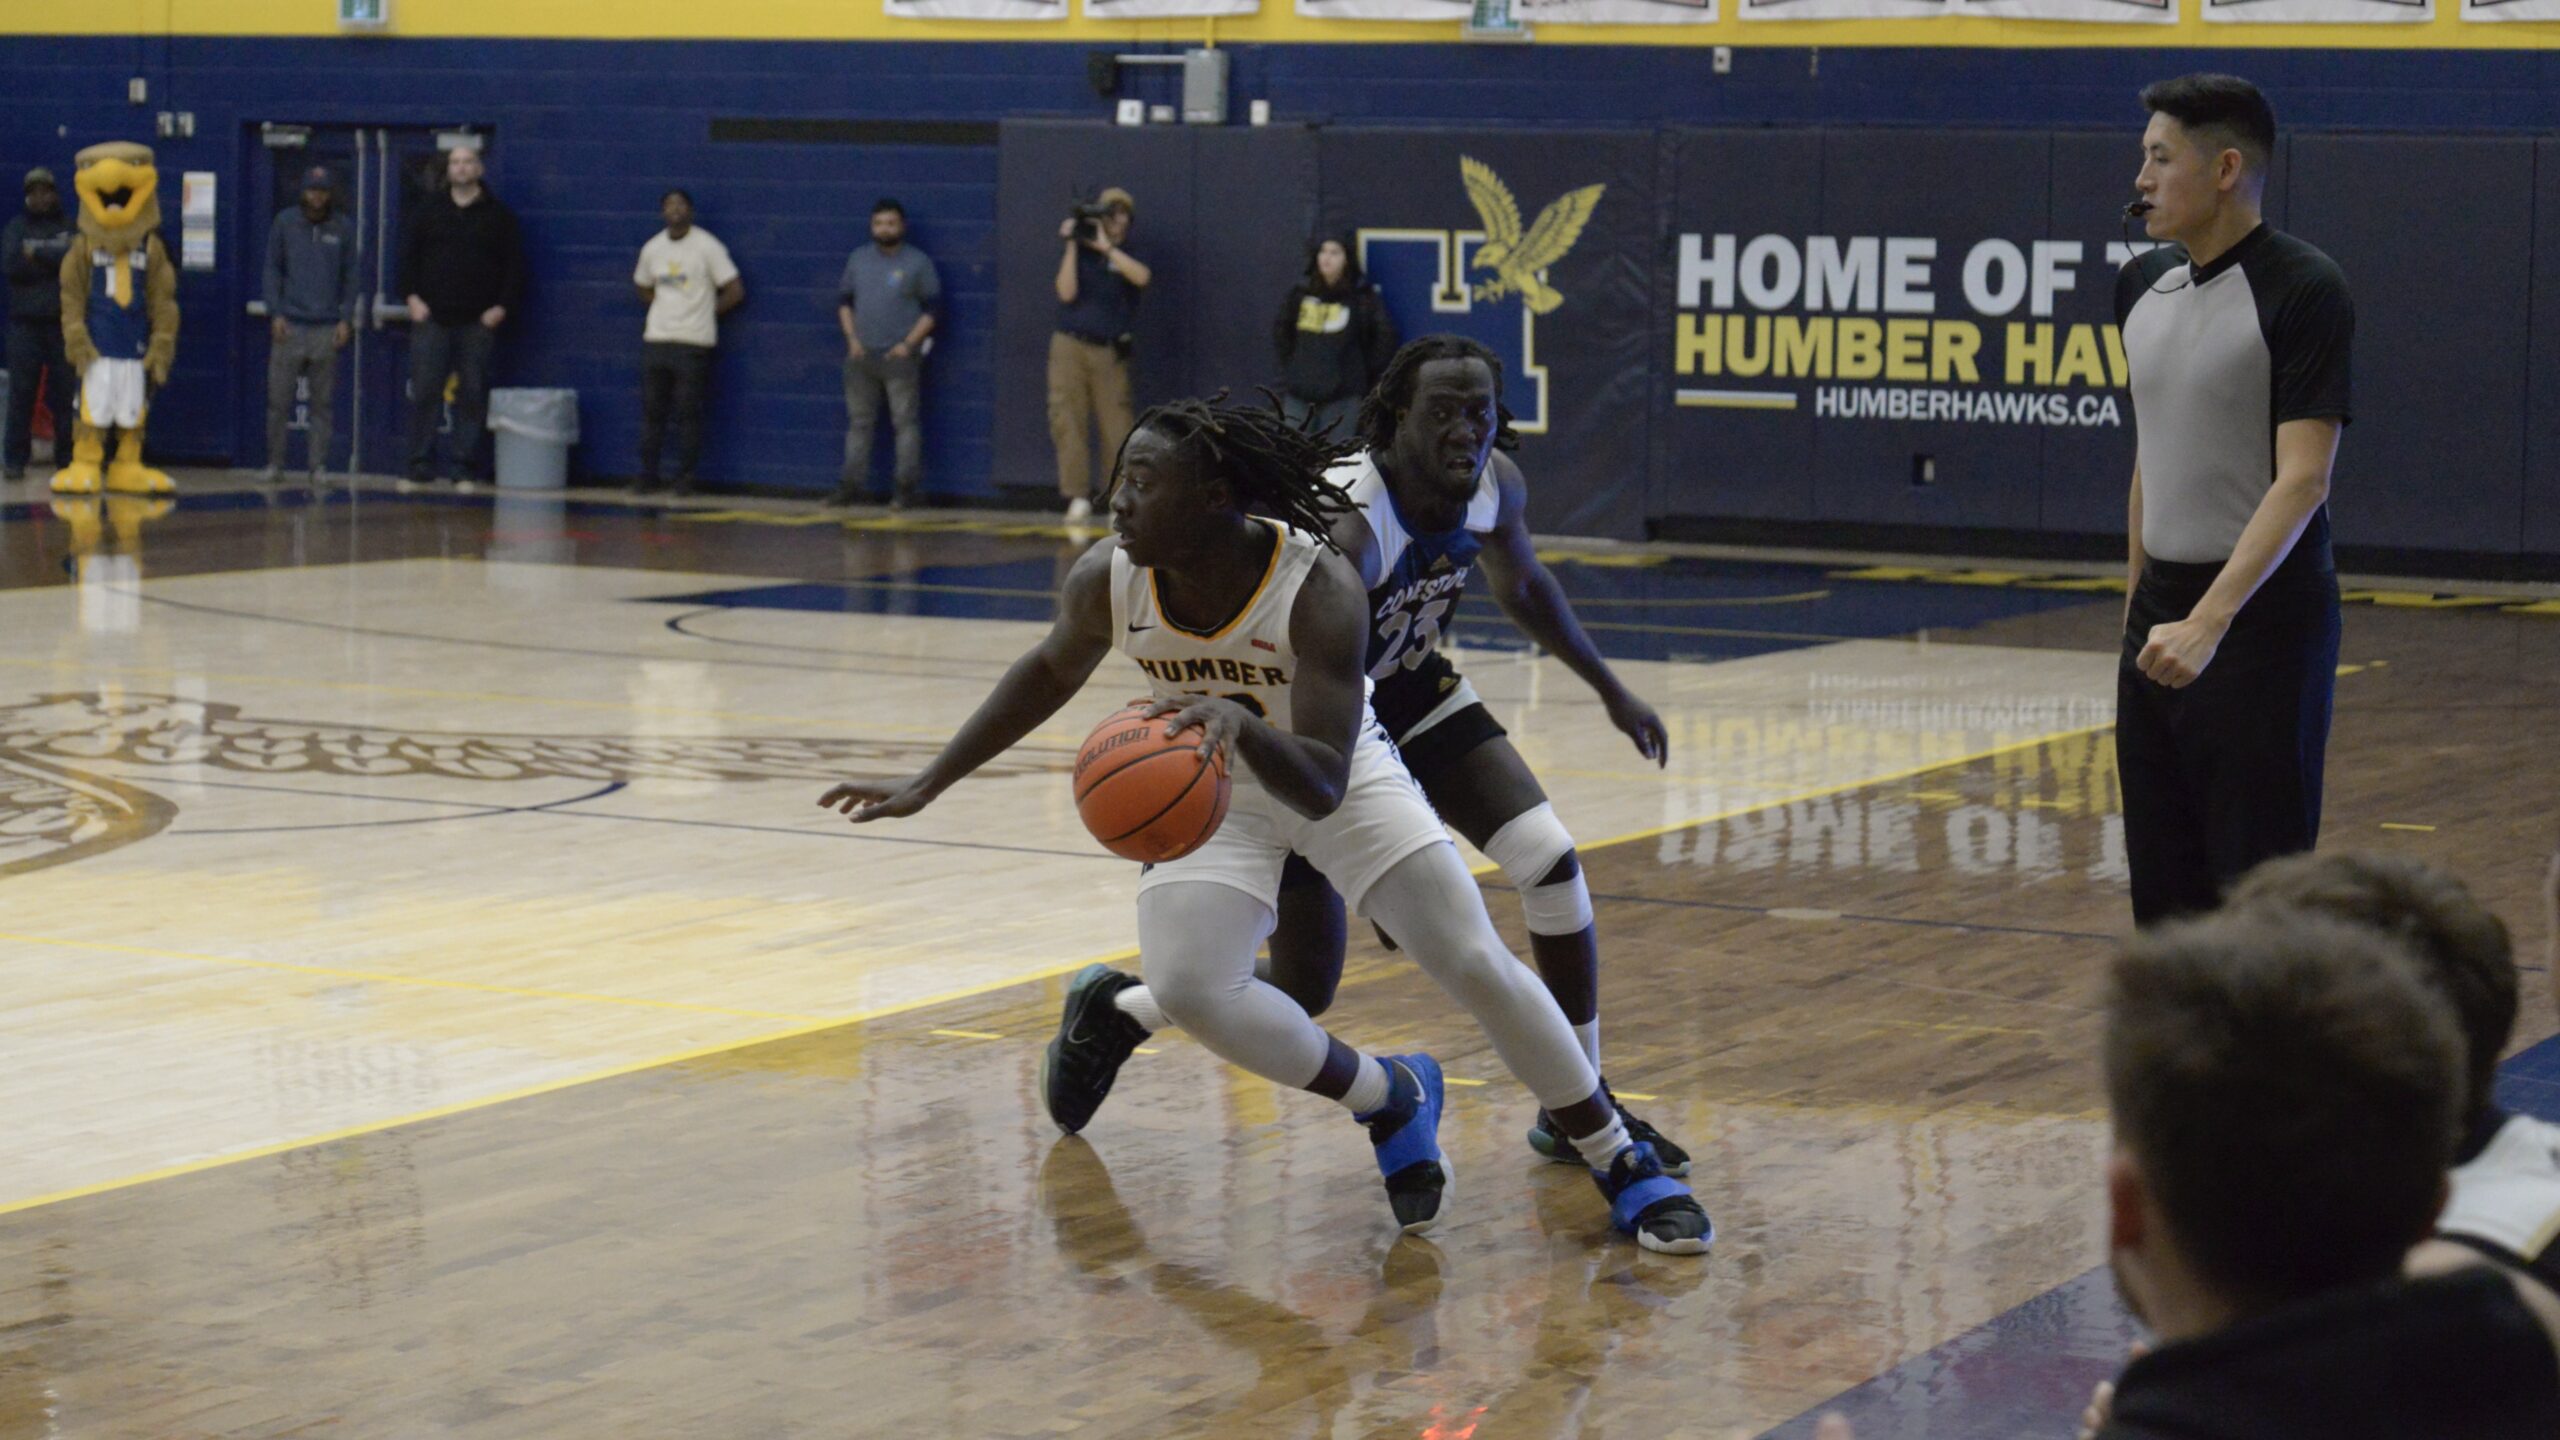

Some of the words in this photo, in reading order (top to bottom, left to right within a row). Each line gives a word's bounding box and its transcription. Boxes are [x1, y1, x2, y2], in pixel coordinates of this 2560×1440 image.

[1677, 233, 1936, 313] HOME
[1963, 238, 2083, 316] OF
[1675, 313, 1982, 382] HUMBER
[1815, 387, 2120, 426] HUMBERHAWKS.CA
[1135, 656, 1291, 686] HUMBER
